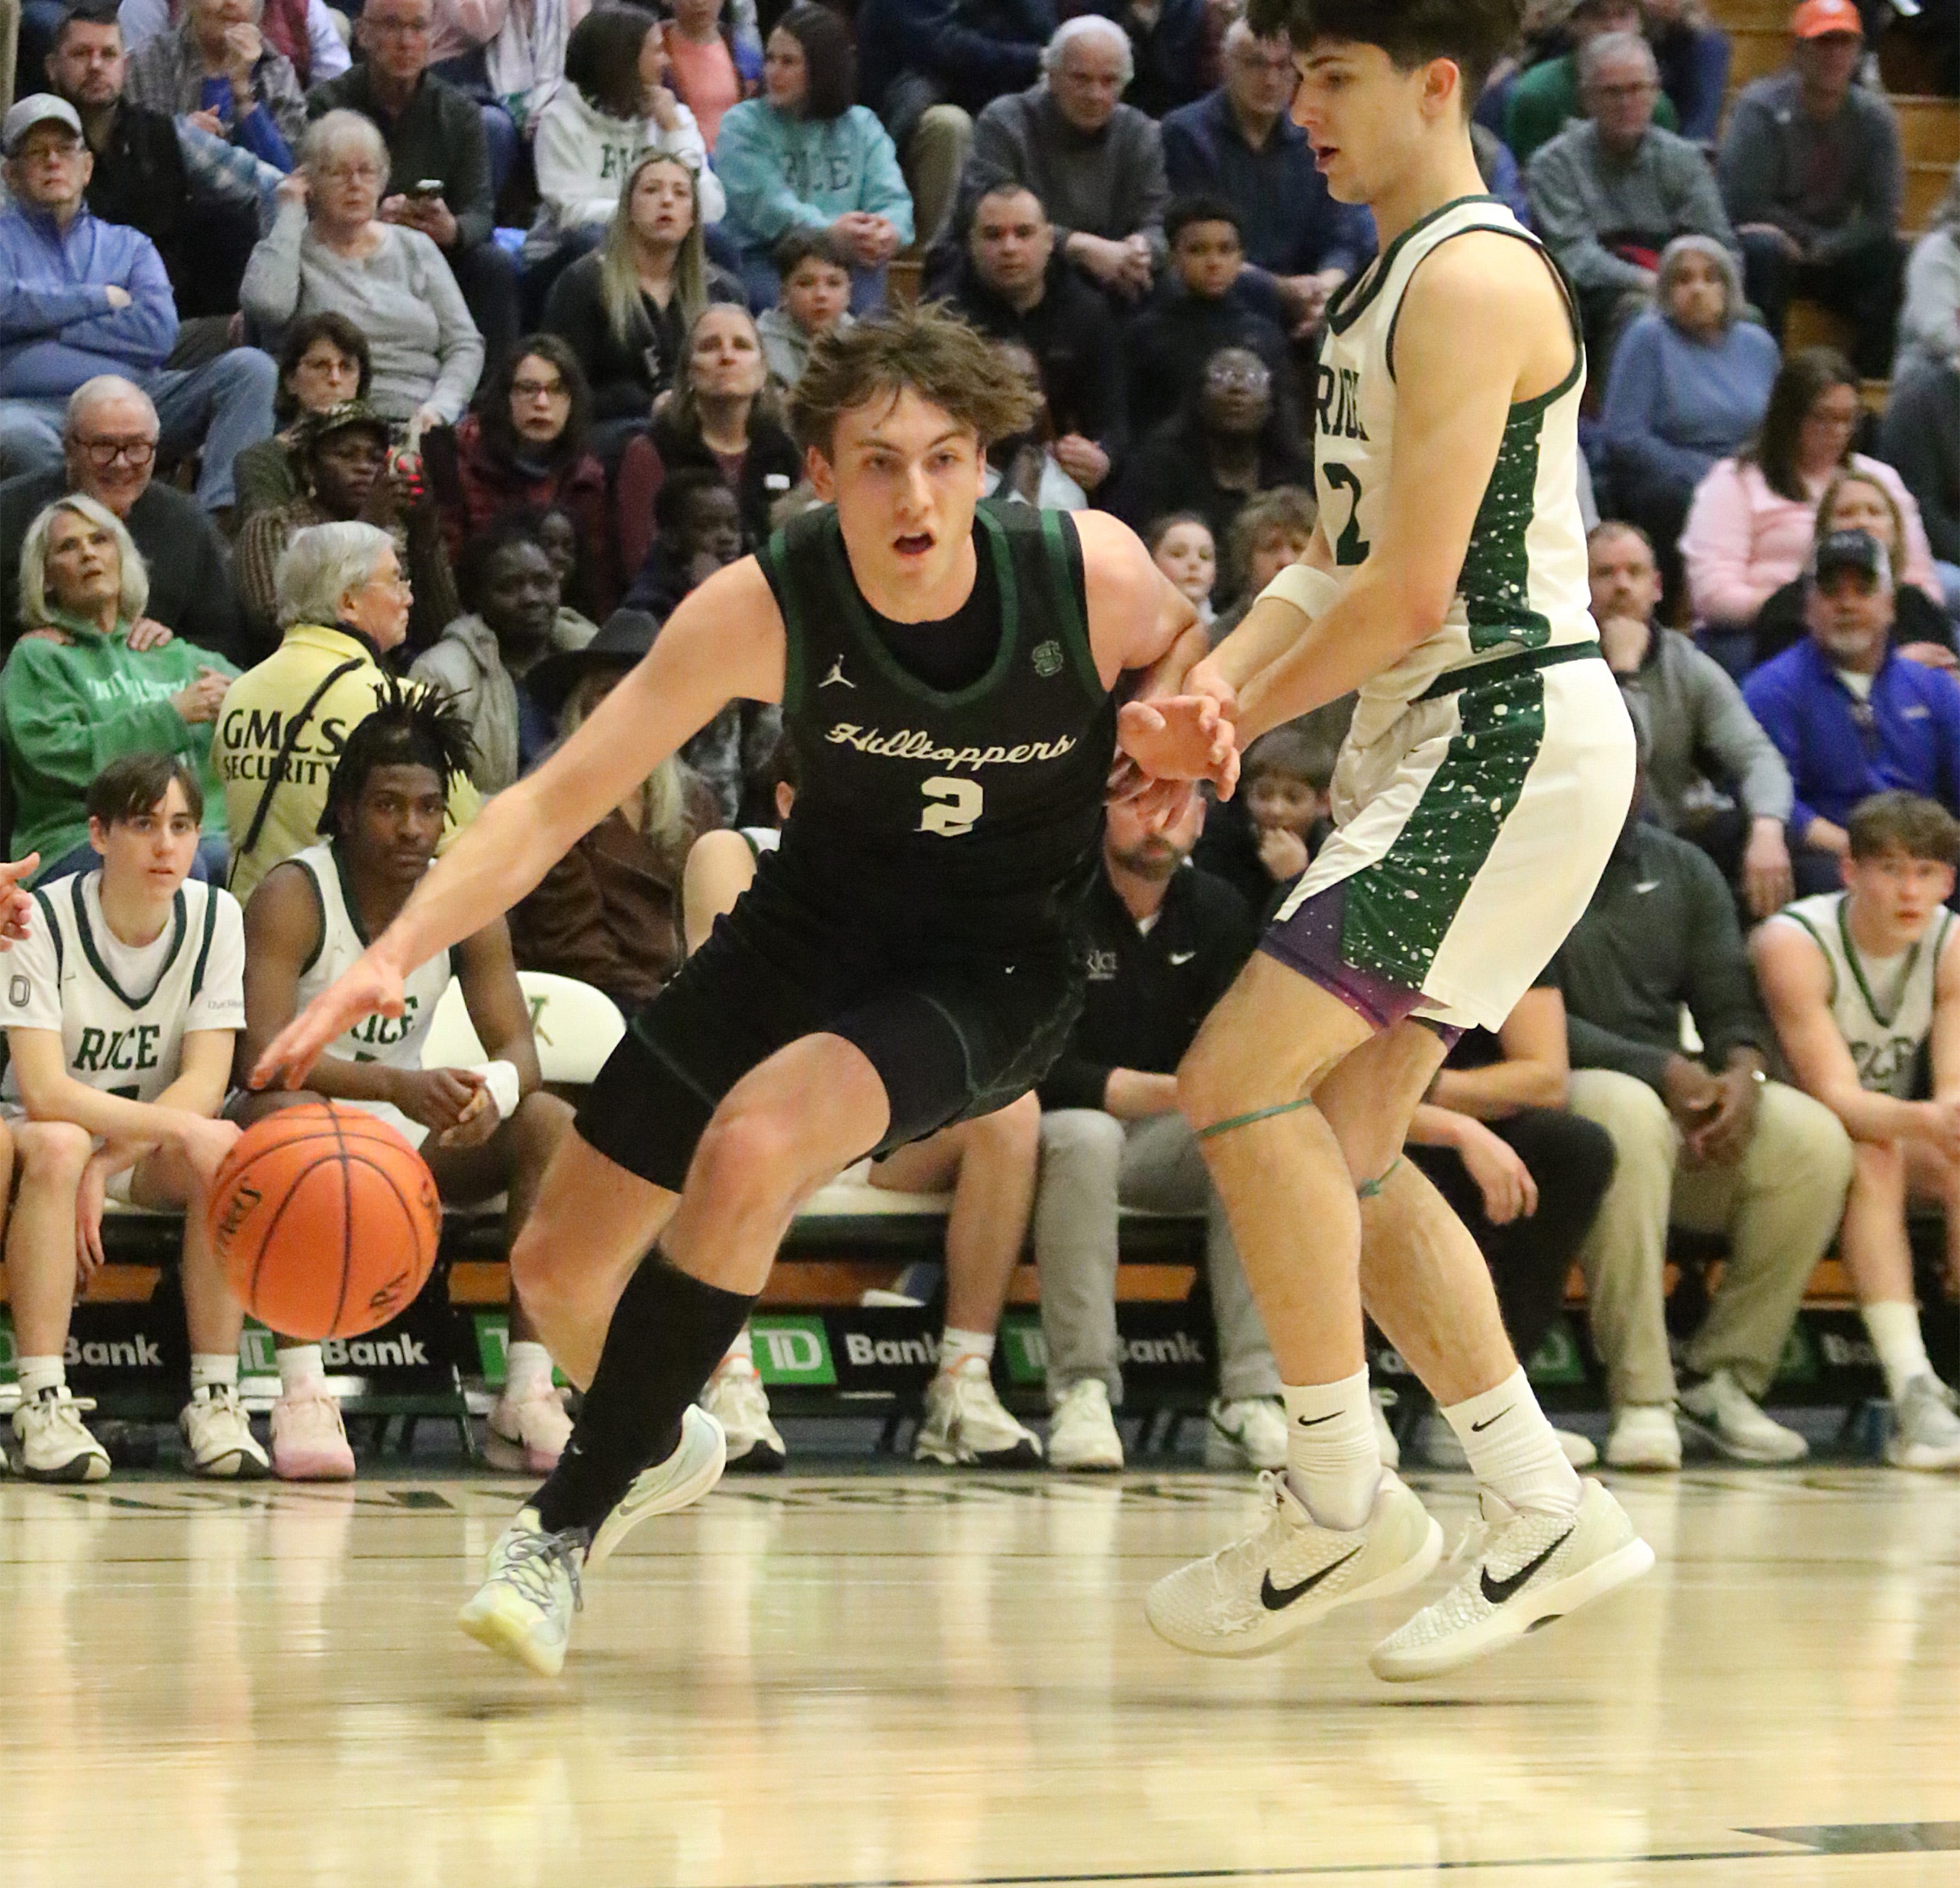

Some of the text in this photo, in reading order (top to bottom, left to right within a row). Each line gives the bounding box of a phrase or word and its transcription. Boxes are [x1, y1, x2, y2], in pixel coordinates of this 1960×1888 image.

[223, 709, 347, 757] GMCS
[824, 722, 1077, 772] Hilltoppers
[917, 776, 983, 837] 2
[349, 996, 418, 1045] ICE
[72, 1024, 160, 1072] RICE
[64, 1332, 164, 1366] Bank
[321, 1332, 430, 1367] Bank
[752, 1329, 943, 1371] TD Bank
